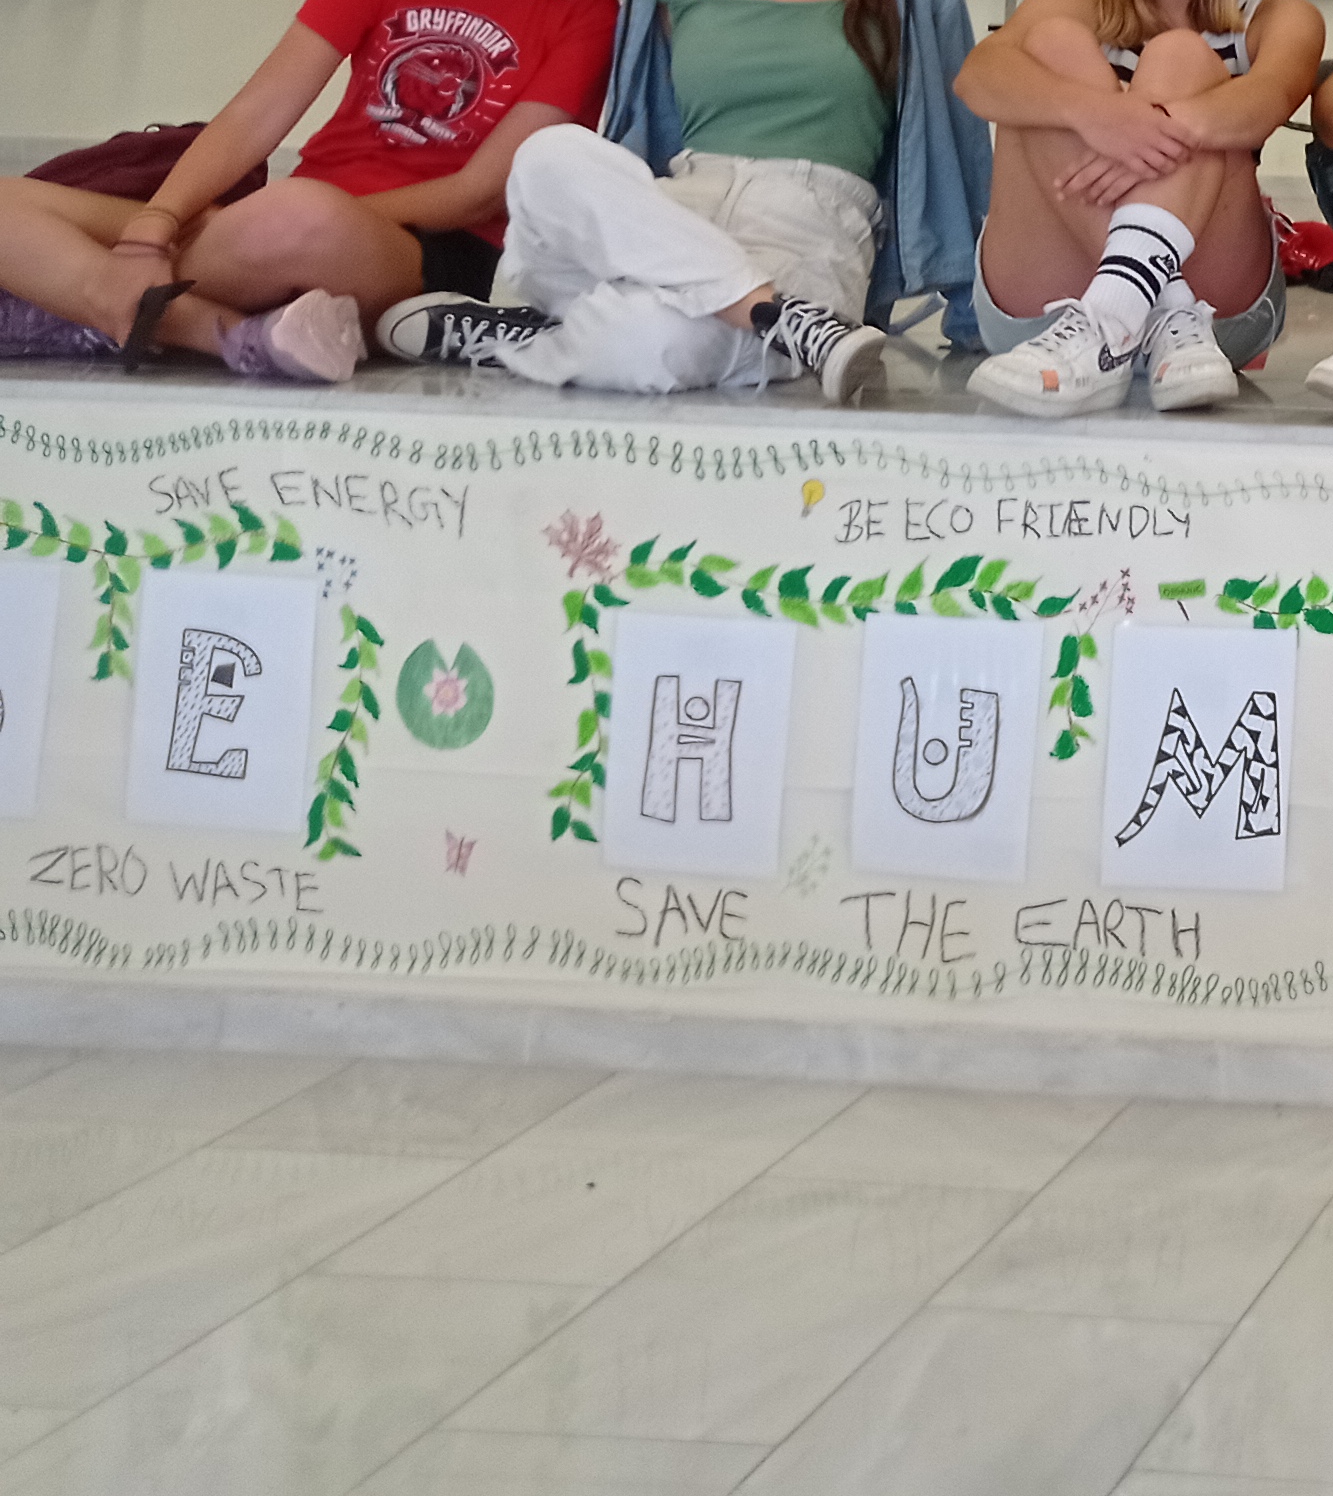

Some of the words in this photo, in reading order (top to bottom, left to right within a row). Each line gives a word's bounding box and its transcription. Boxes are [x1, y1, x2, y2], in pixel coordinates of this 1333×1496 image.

[405, 7, 512, 60] GRYFFINDOR
[148, 466, 246, 515] SAVE
[270, 470, 469, 540] ENERGY
[835, 498, 889, 543] BE
[905, 497, 974, 541] ECO
[29, 844, 148, 897] ZERO
[169, 857, 325, 913] WASTE
[615, 877, 749, 947] SAVE
[840, 889, 977, 964] THE
[1014, 898, 1201, 961] EARTH
